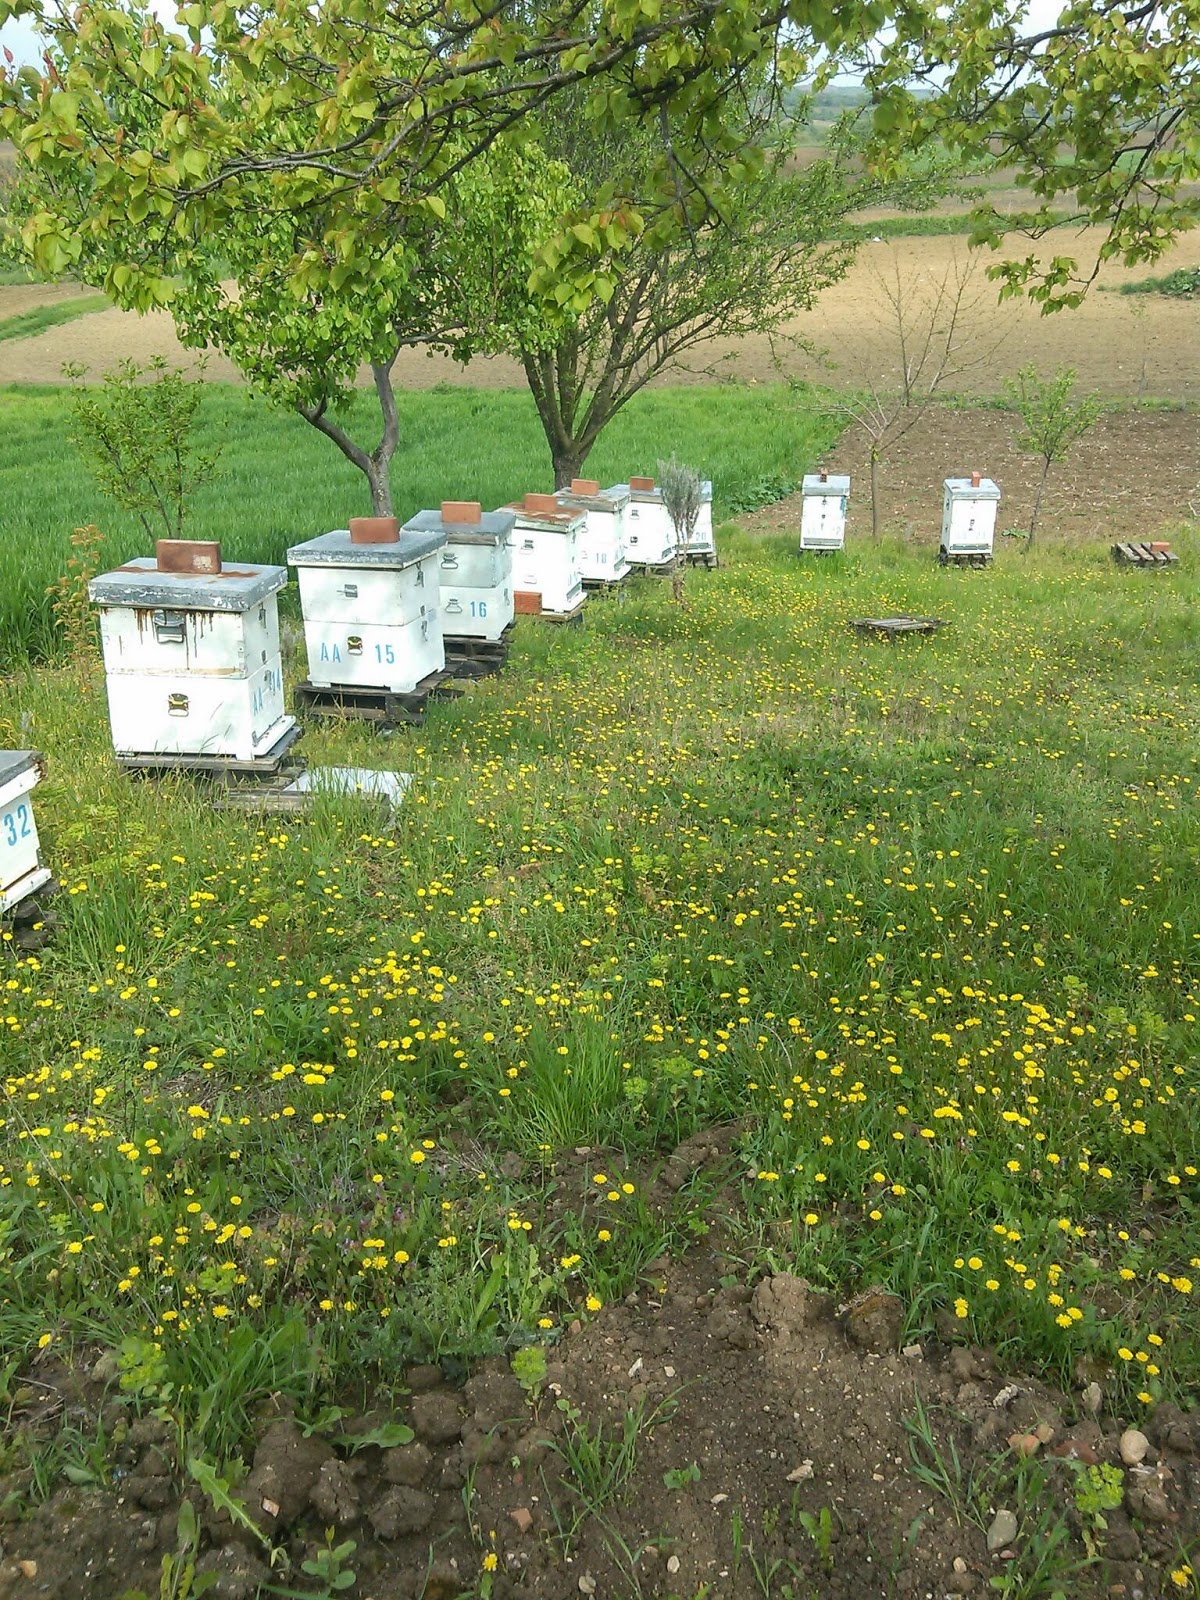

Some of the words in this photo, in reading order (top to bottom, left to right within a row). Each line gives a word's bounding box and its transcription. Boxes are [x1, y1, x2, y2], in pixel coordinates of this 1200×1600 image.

[470, 601, 487, 618] 16
[320, 642, 342, 664] AA
[375, 644, 395, 664] 15
[4, 804, 32, 847] 32
